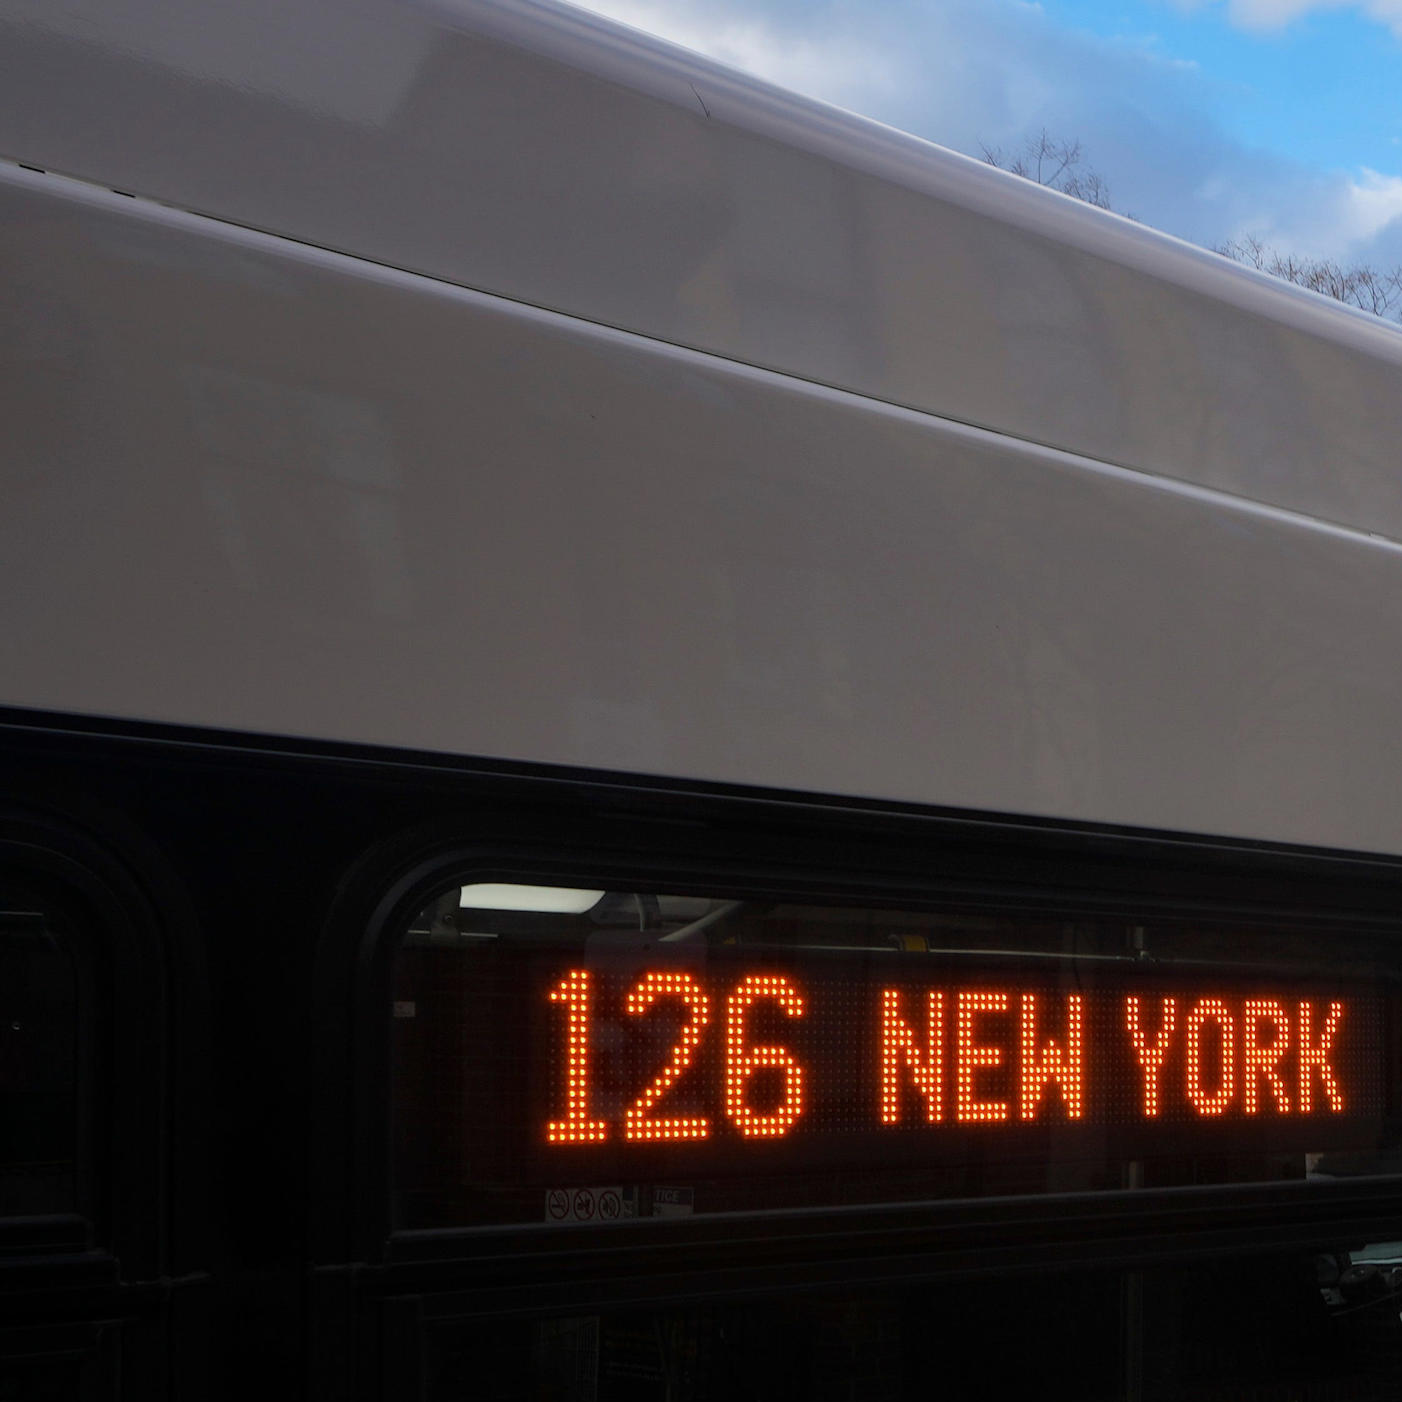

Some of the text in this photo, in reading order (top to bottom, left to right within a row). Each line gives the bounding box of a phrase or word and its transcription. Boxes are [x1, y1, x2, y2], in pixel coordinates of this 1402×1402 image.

[546, 968, 1343, 1144] 126 NEW YORK
